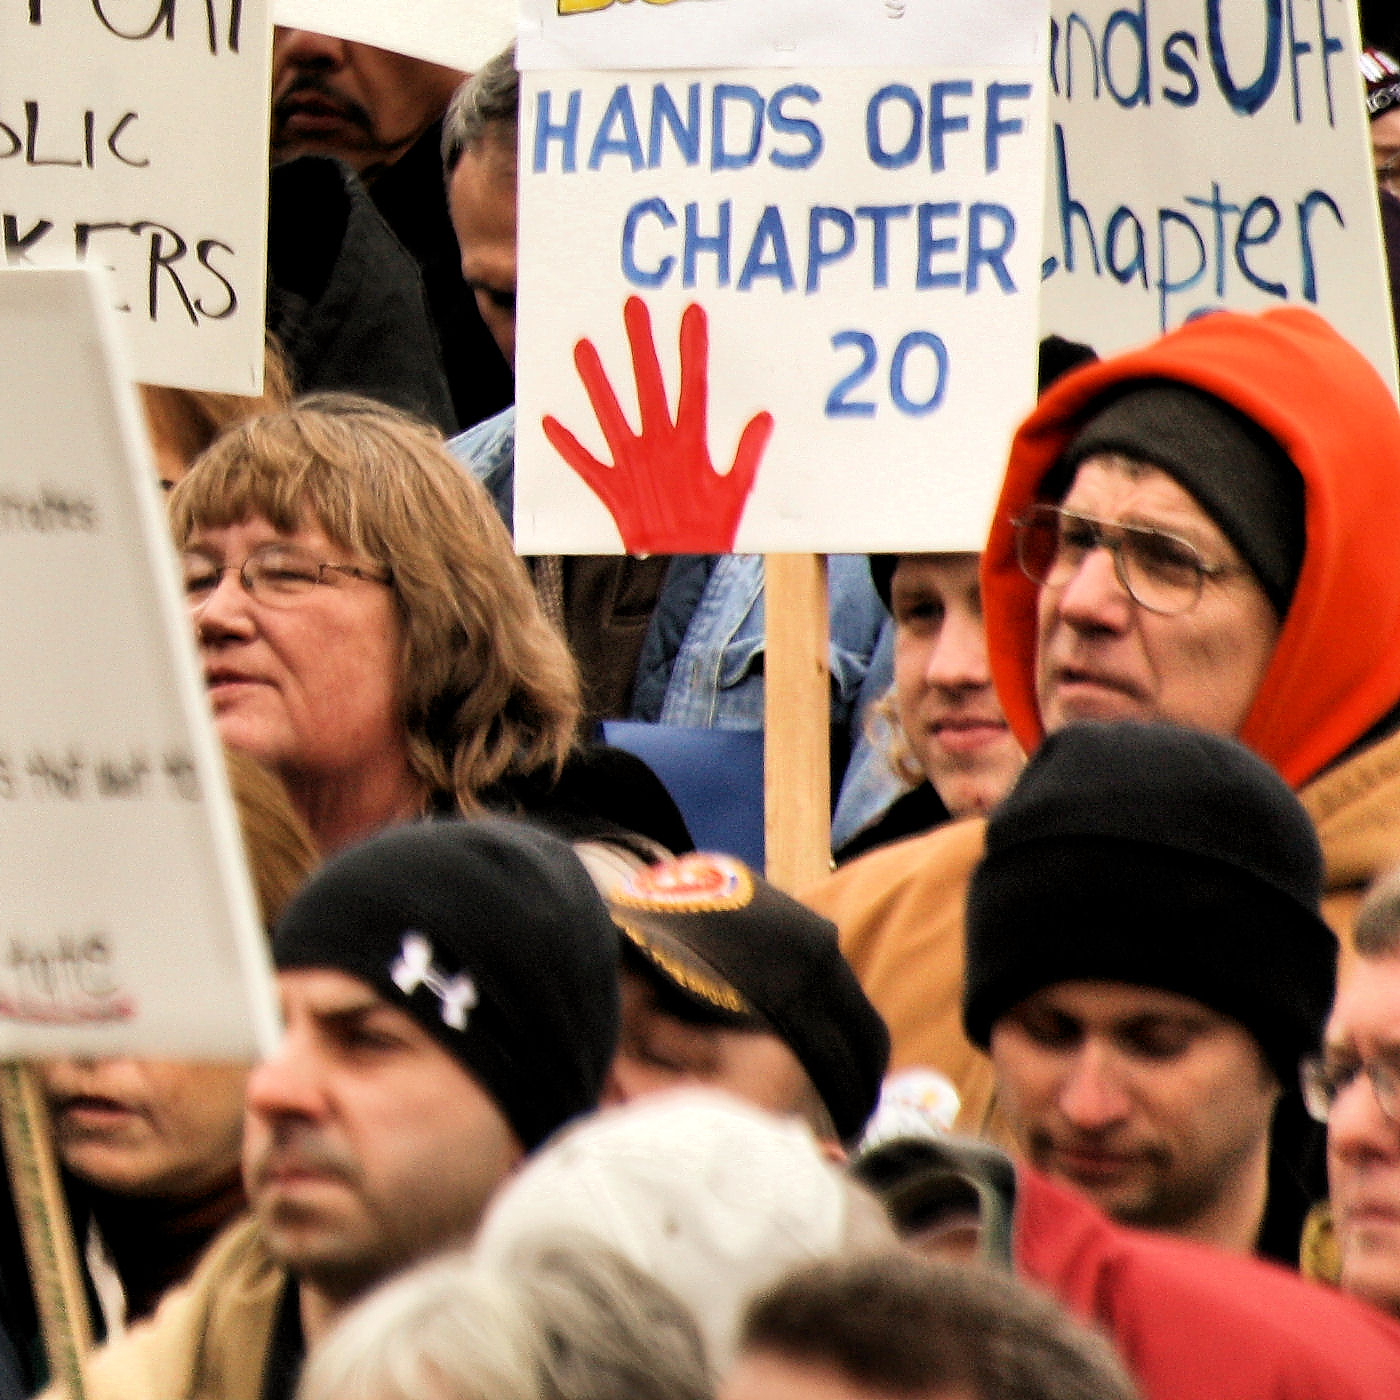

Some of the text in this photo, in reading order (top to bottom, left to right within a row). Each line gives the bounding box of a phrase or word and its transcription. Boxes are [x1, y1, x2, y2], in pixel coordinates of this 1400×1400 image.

[533, 80, 1033, 174] HANDS OFF
[621, 197, 1018, 293] CHAPTER
[1042, 122, 1346, 336] hapter
[825, 330, 950, 419] 20
